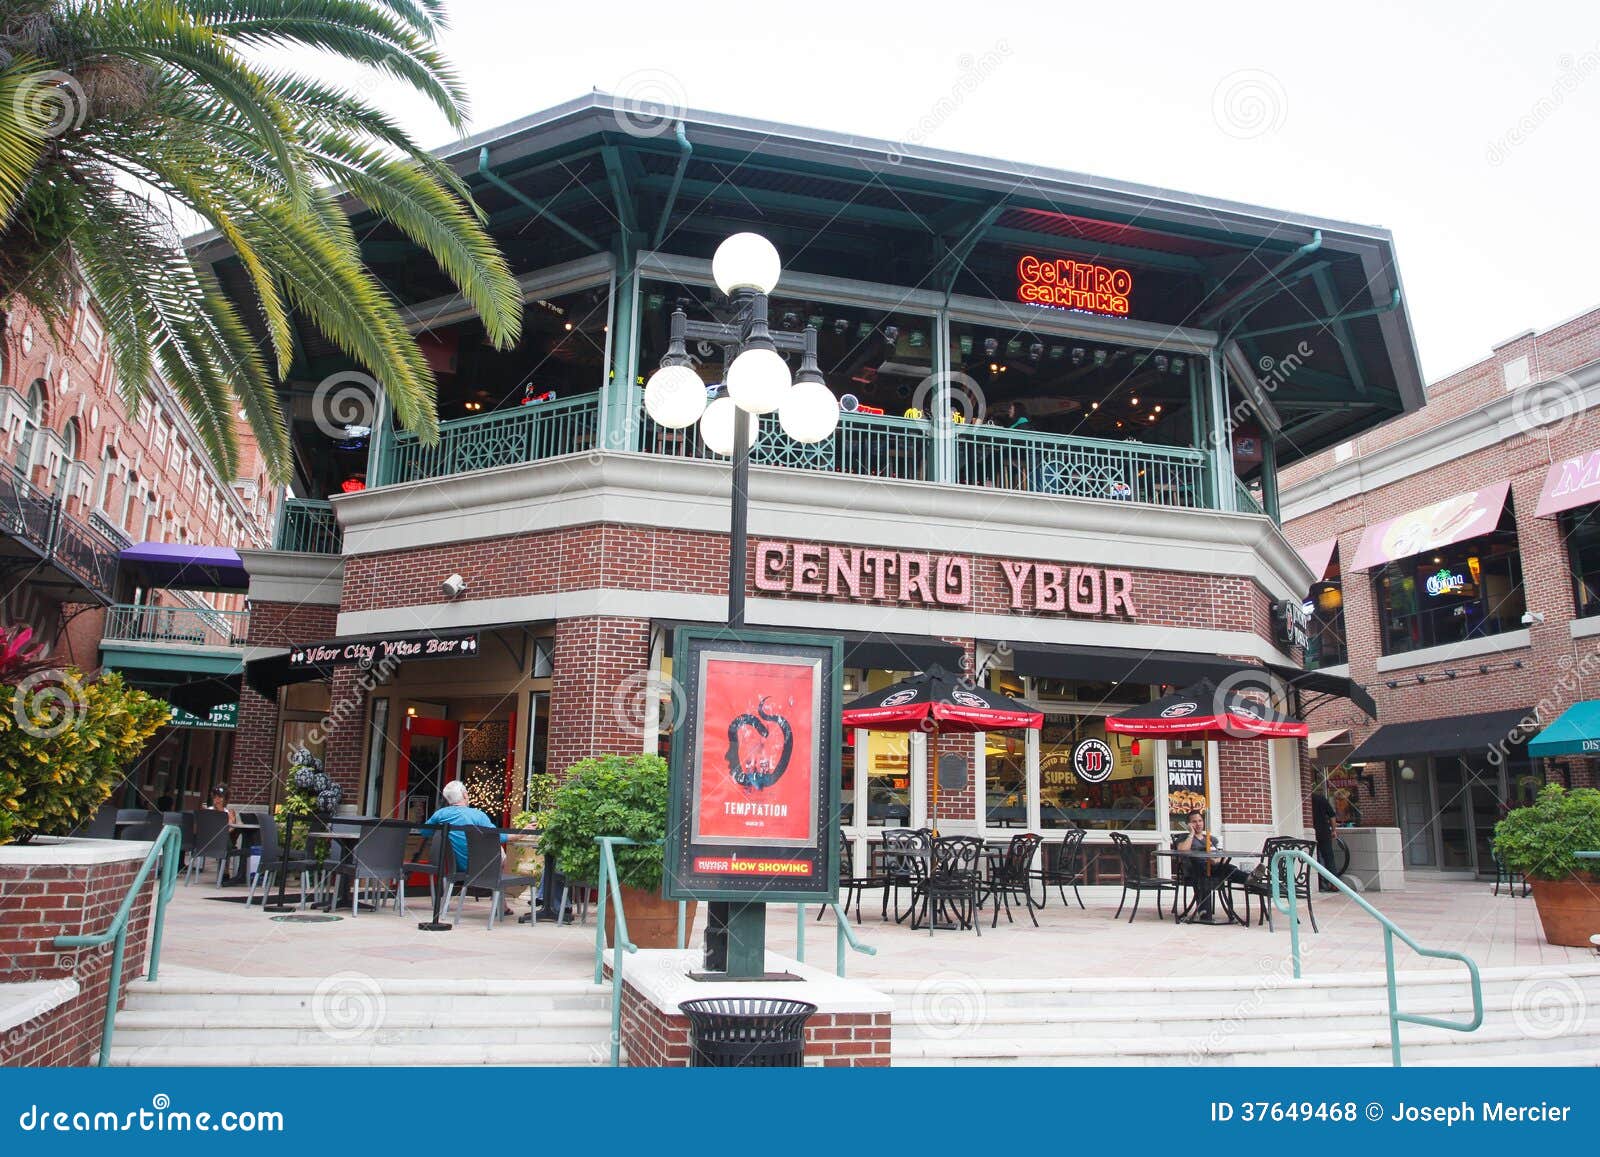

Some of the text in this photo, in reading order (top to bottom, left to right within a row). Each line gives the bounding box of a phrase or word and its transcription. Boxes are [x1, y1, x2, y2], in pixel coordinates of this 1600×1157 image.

[754, 541, 1137, 617] CENTRO YBOR
[306, 639, 459, 664] Ybor City Wine Bar
[1085, 751, 1102, 771] JJ
[1168, 759, 1202, 769] WE'D LIKE TO
[1168, 772, 1203, 786] PARTY!
[724, 801, 788, 817] TEMPTATION
[731, 862, 756, 872] NOW
[757, 862, 809, 873] SHOWING
